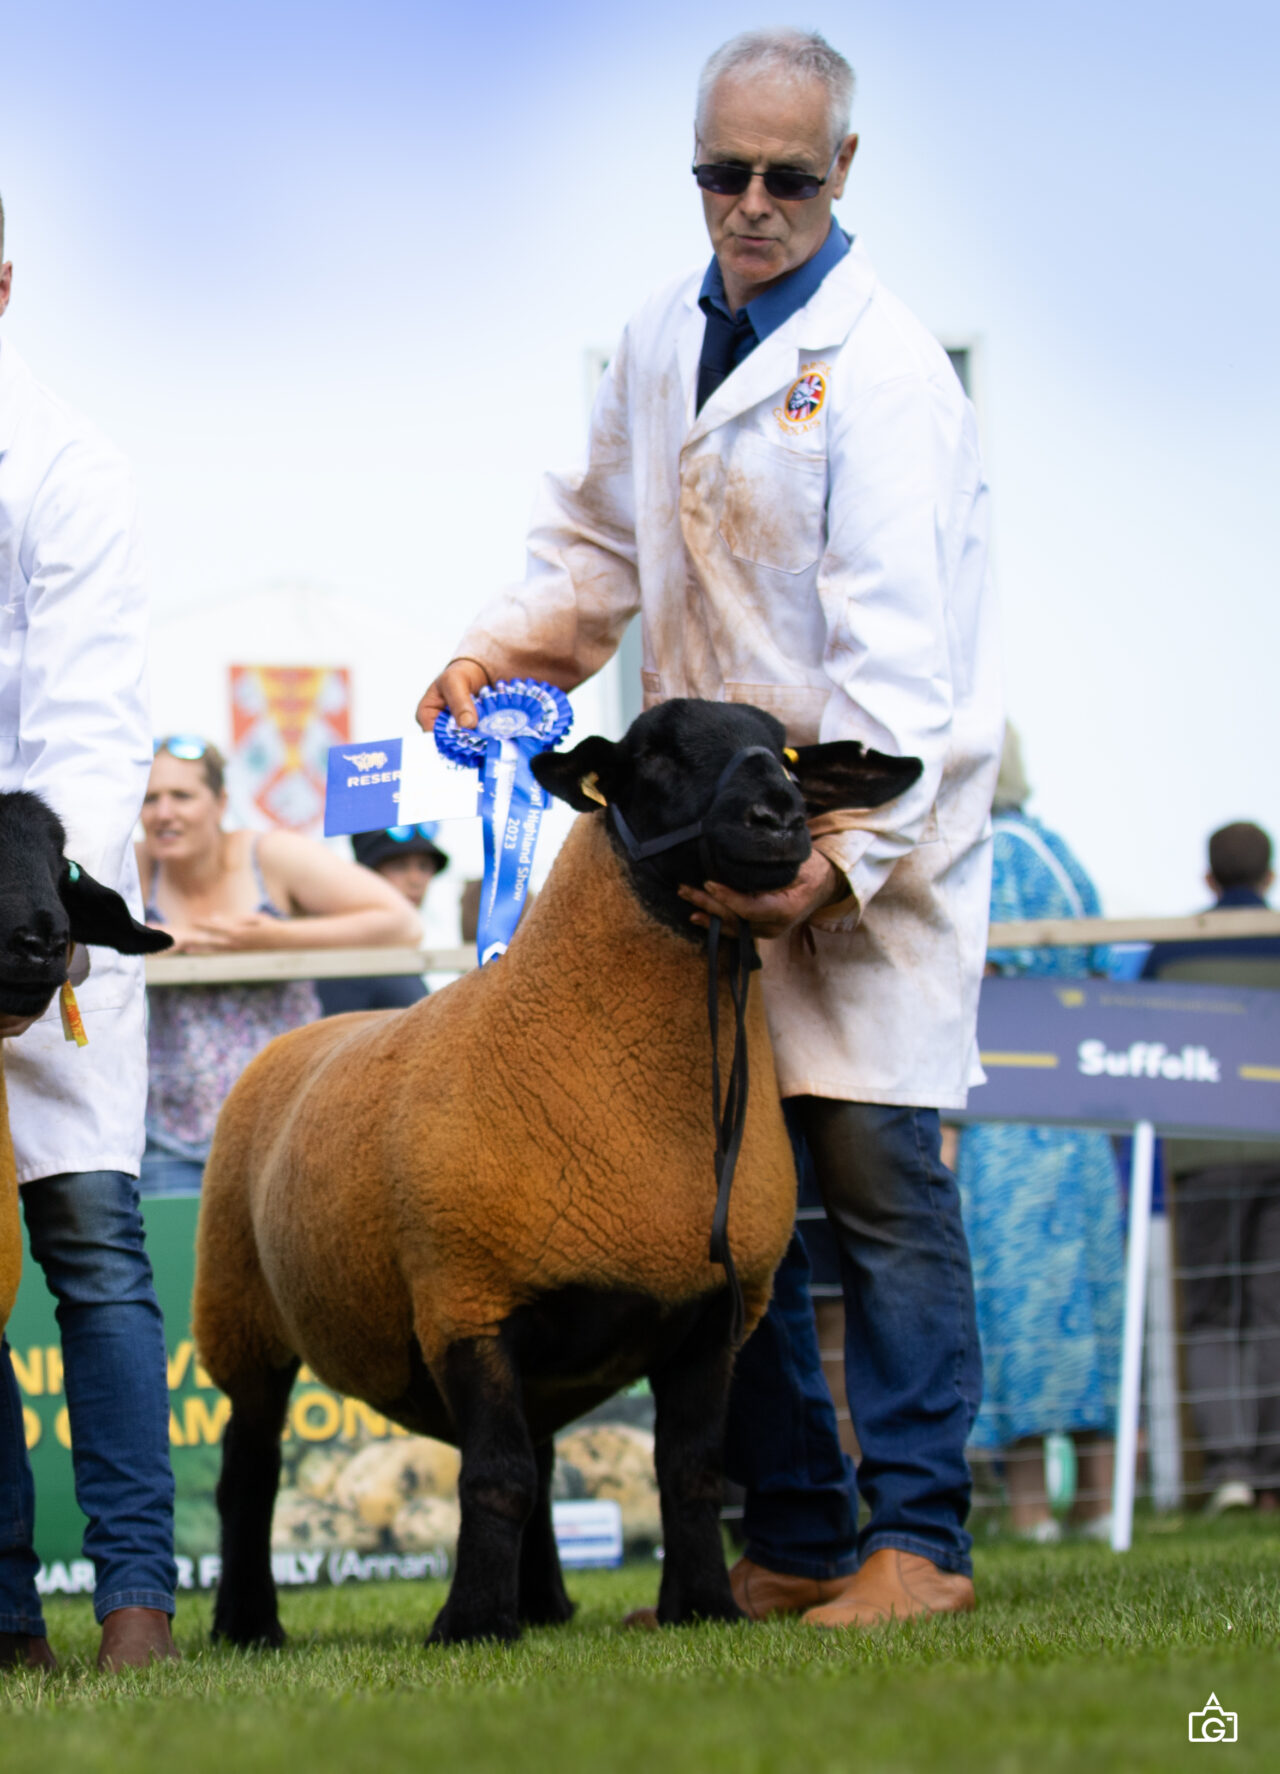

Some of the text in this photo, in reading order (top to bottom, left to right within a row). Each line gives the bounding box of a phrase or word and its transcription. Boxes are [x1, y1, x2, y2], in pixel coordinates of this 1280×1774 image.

[503, 818, 520, 849] 2023
[519, 808, 540, 864] Highland
[513, 866, 529, 901] Show
[1077, 1038, 1221, 1083] Suffolk
[328, 1546, 448, 1587] (Annan)
